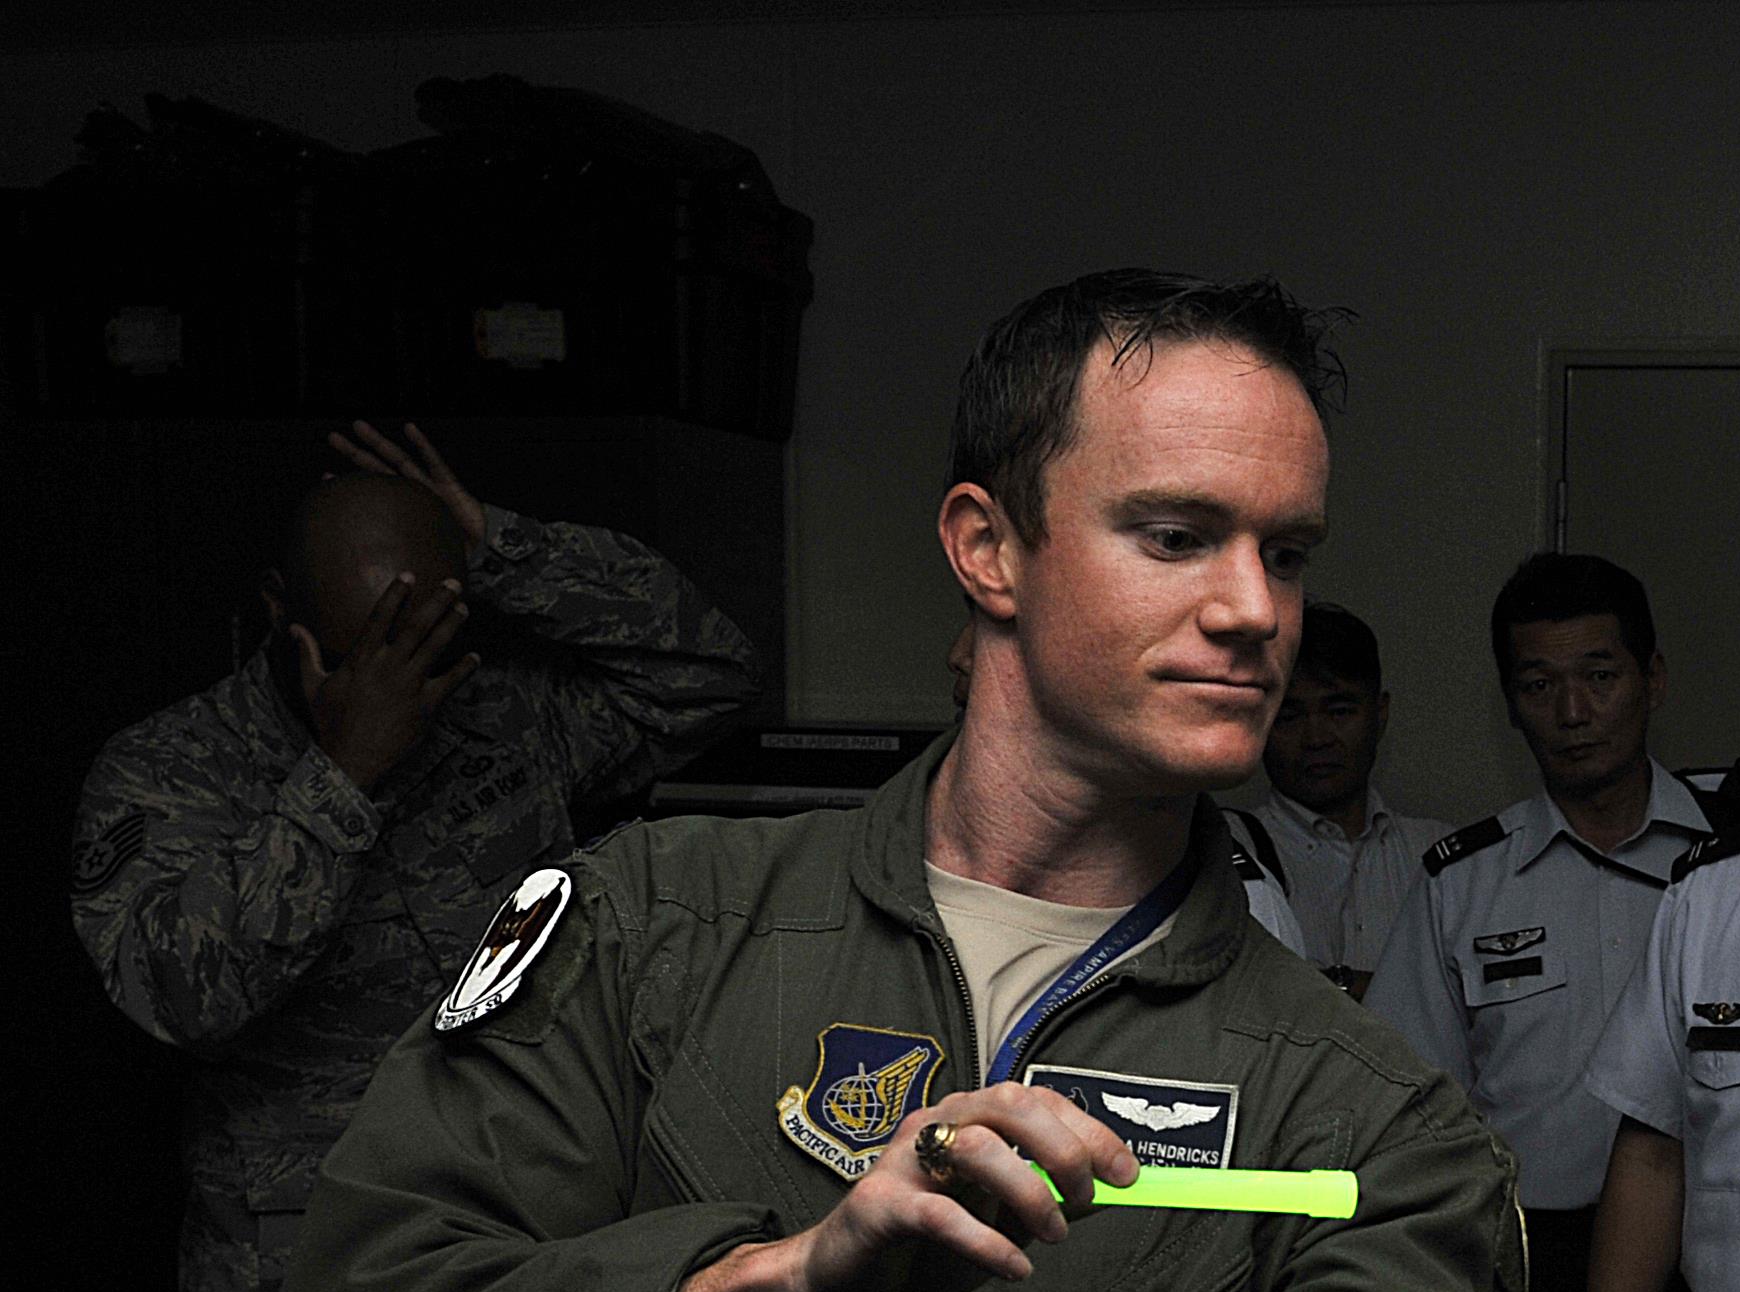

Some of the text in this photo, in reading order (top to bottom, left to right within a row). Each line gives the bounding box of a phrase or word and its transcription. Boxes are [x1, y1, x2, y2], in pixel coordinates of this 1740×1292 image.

[1064, 946, 1115, 988] VAMPIRE
[786, 1114, 865, 1175] PACIFIC AIR
[1137, 1141, 1220, 1165] HENDRICKS
